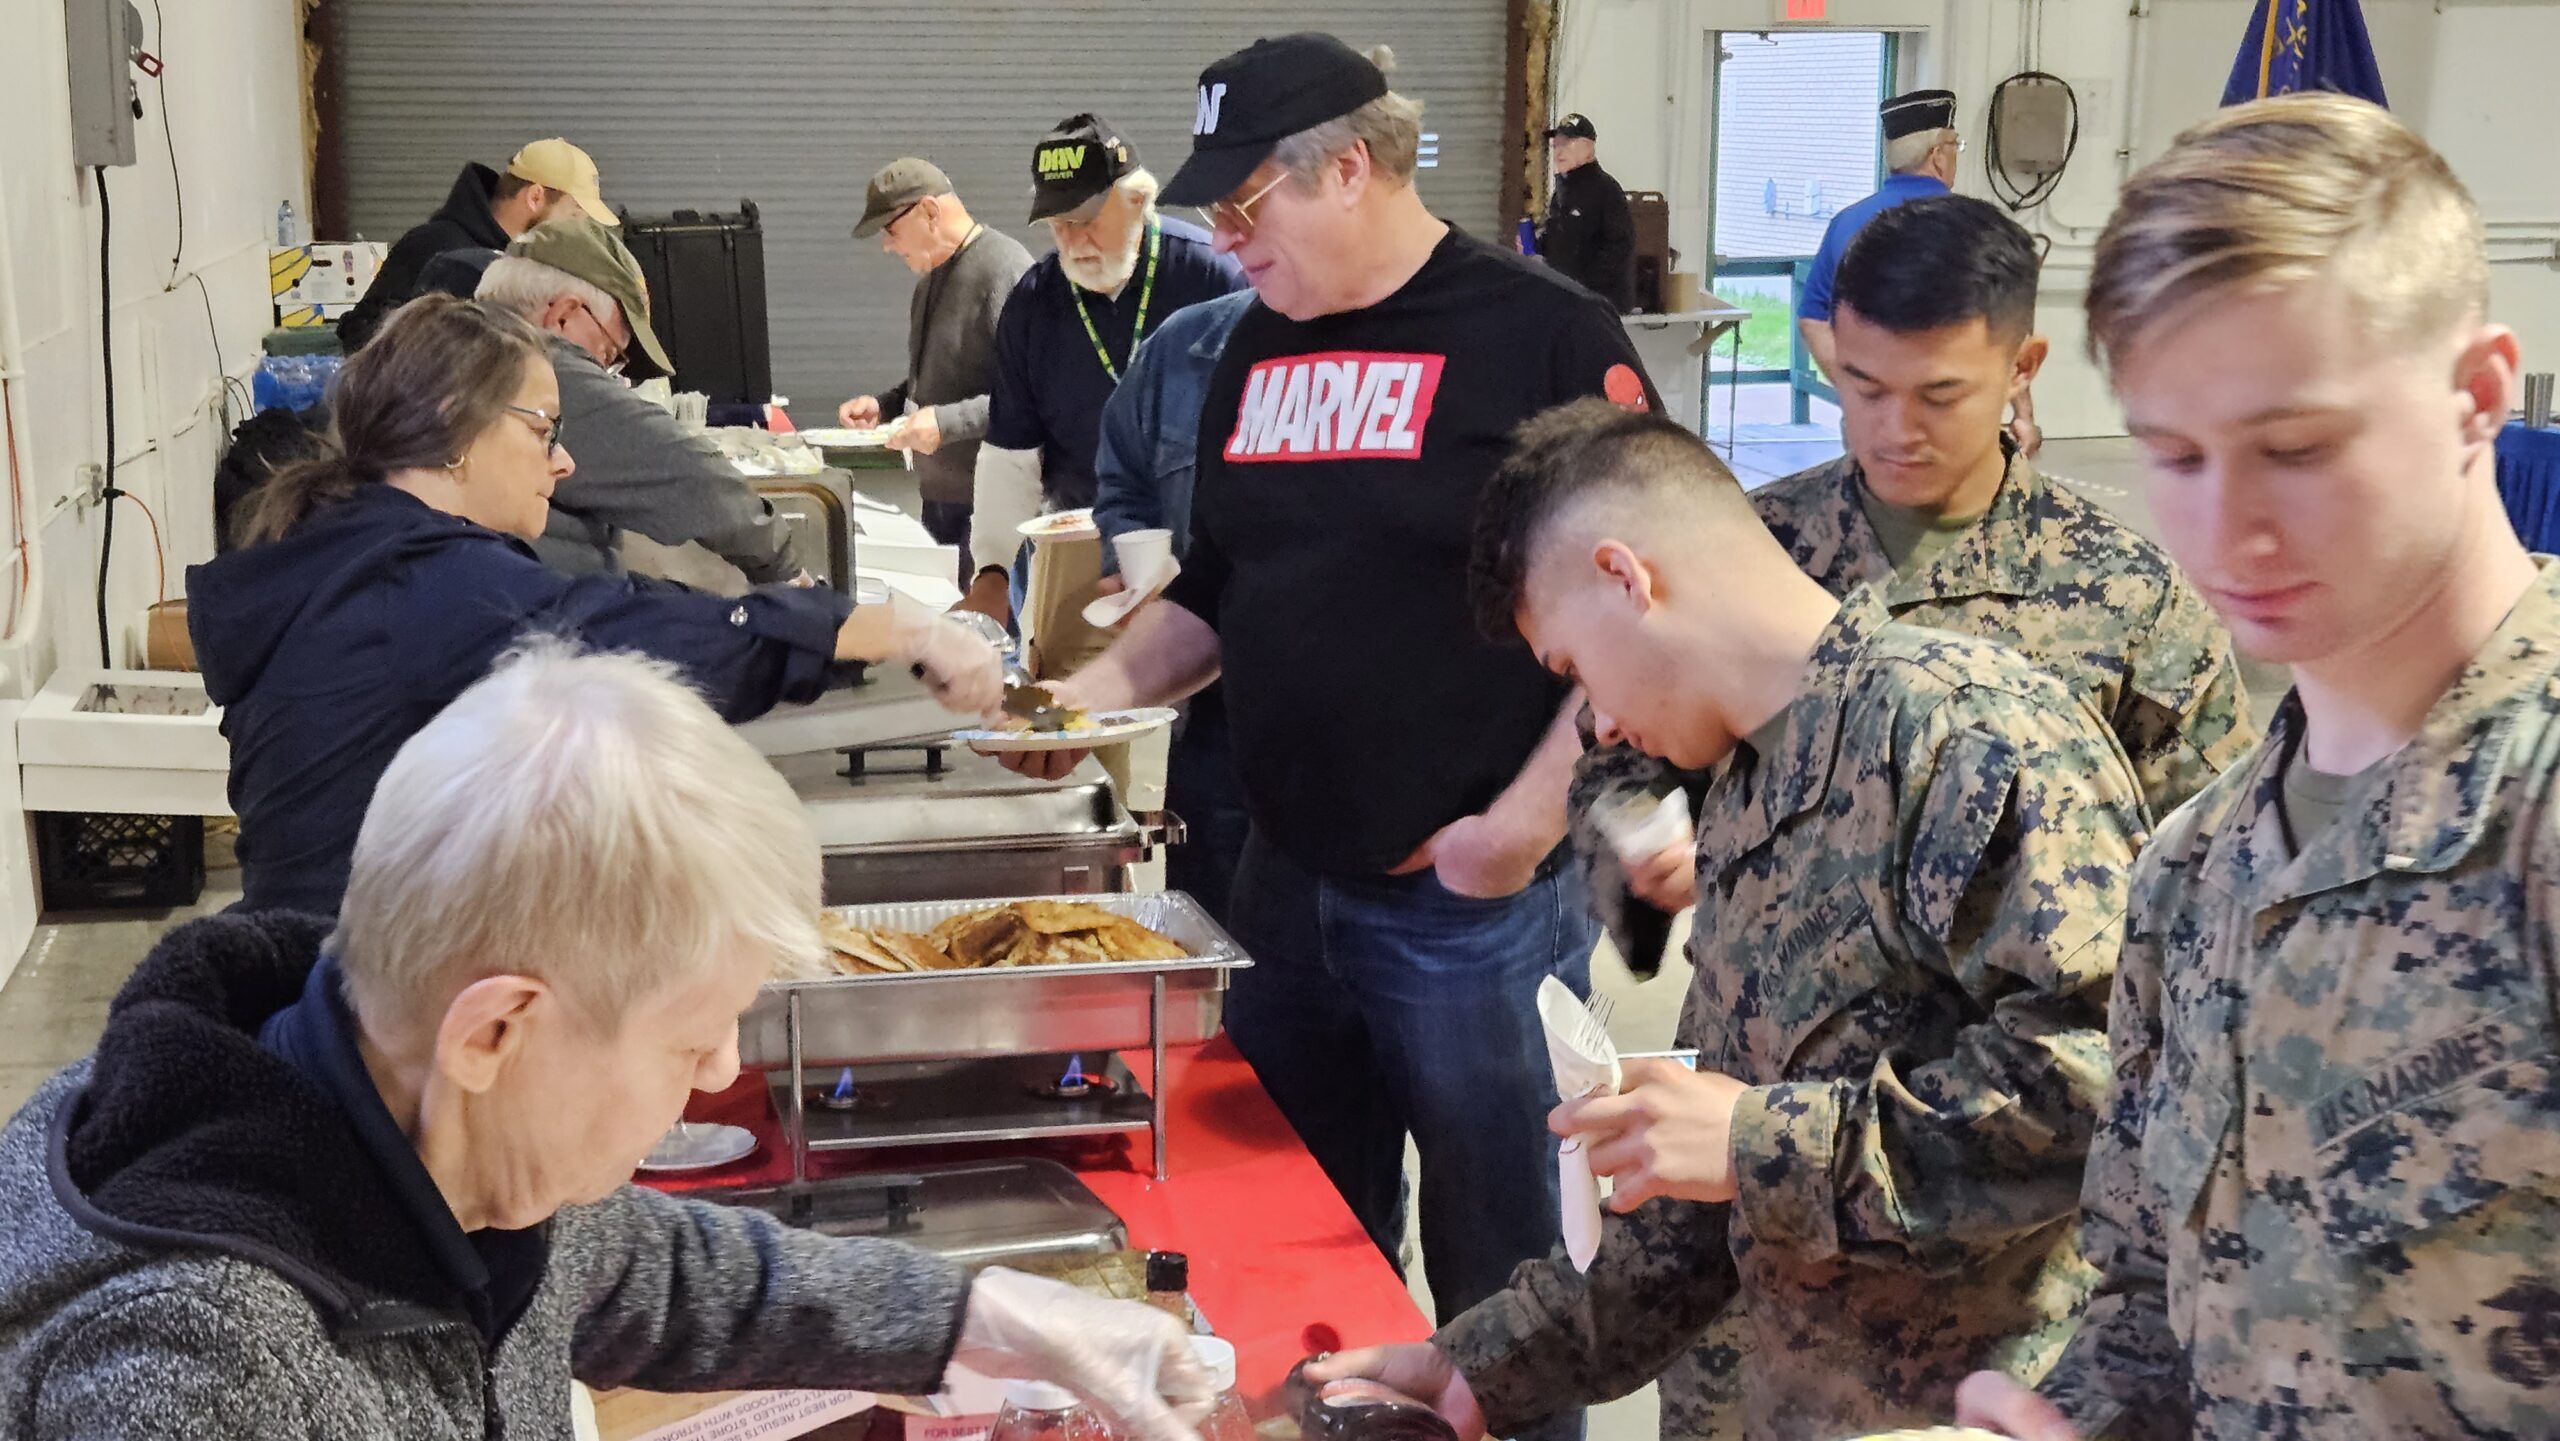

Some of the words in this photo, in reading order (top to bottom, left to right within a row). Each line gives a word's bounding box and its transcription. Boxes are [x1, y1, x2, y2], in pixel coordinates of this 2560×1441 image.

[1038, 145, 1087, 172] DAV
[1229, 360, 1424, 455] MARVEL
[1777, 895, 1840, 977] MARINES
[2364, 1023, 2504, 1113] MARINES
[735, 1396, 776, 1415] FOODS
[799, 1400, 827, 1419] BEST
[828, 1391, 854, 1406] FOR
[703, 1411, 735, 1428] WITH
[710, 1417, 748, 1440] STORE
[744, 1412, 796, 1439] RESULTS
